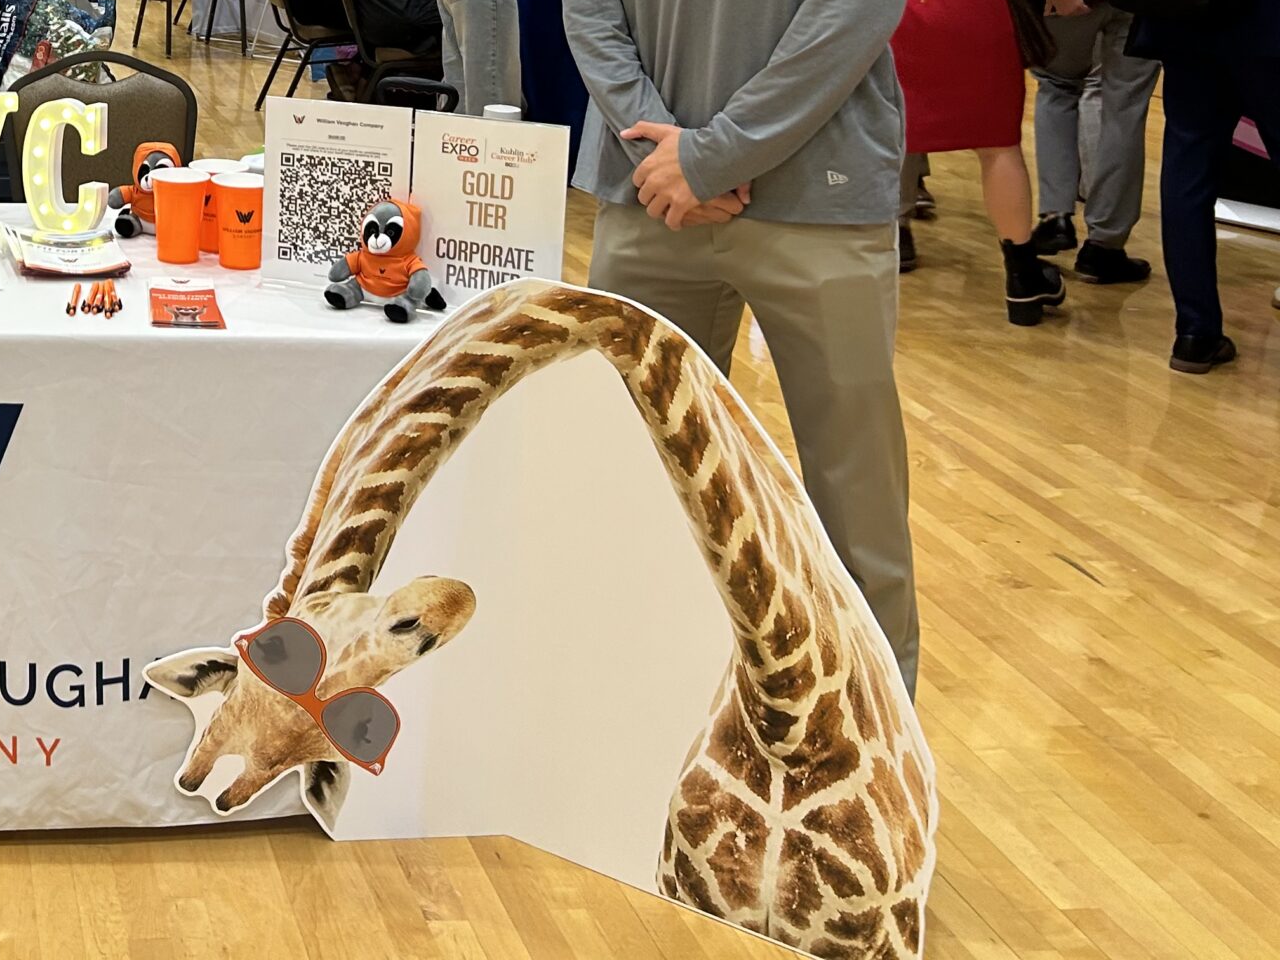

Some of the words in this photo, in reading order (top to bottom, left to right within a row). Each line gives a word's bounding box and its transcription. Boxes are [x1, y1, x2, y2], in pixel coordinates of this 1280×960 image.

[359, 120, 384, 130] Company
[441, 133, 477, 145] Career
[441, 142, 479, 157] EXPO
[491, 153, 516, 162] Career
[517, 156, 533, 164] Hub
[462, 170, 514, 201] GOLD
[465, 200, 507, 231] TIER
[435, 236, 535, 272] CORPORATE
